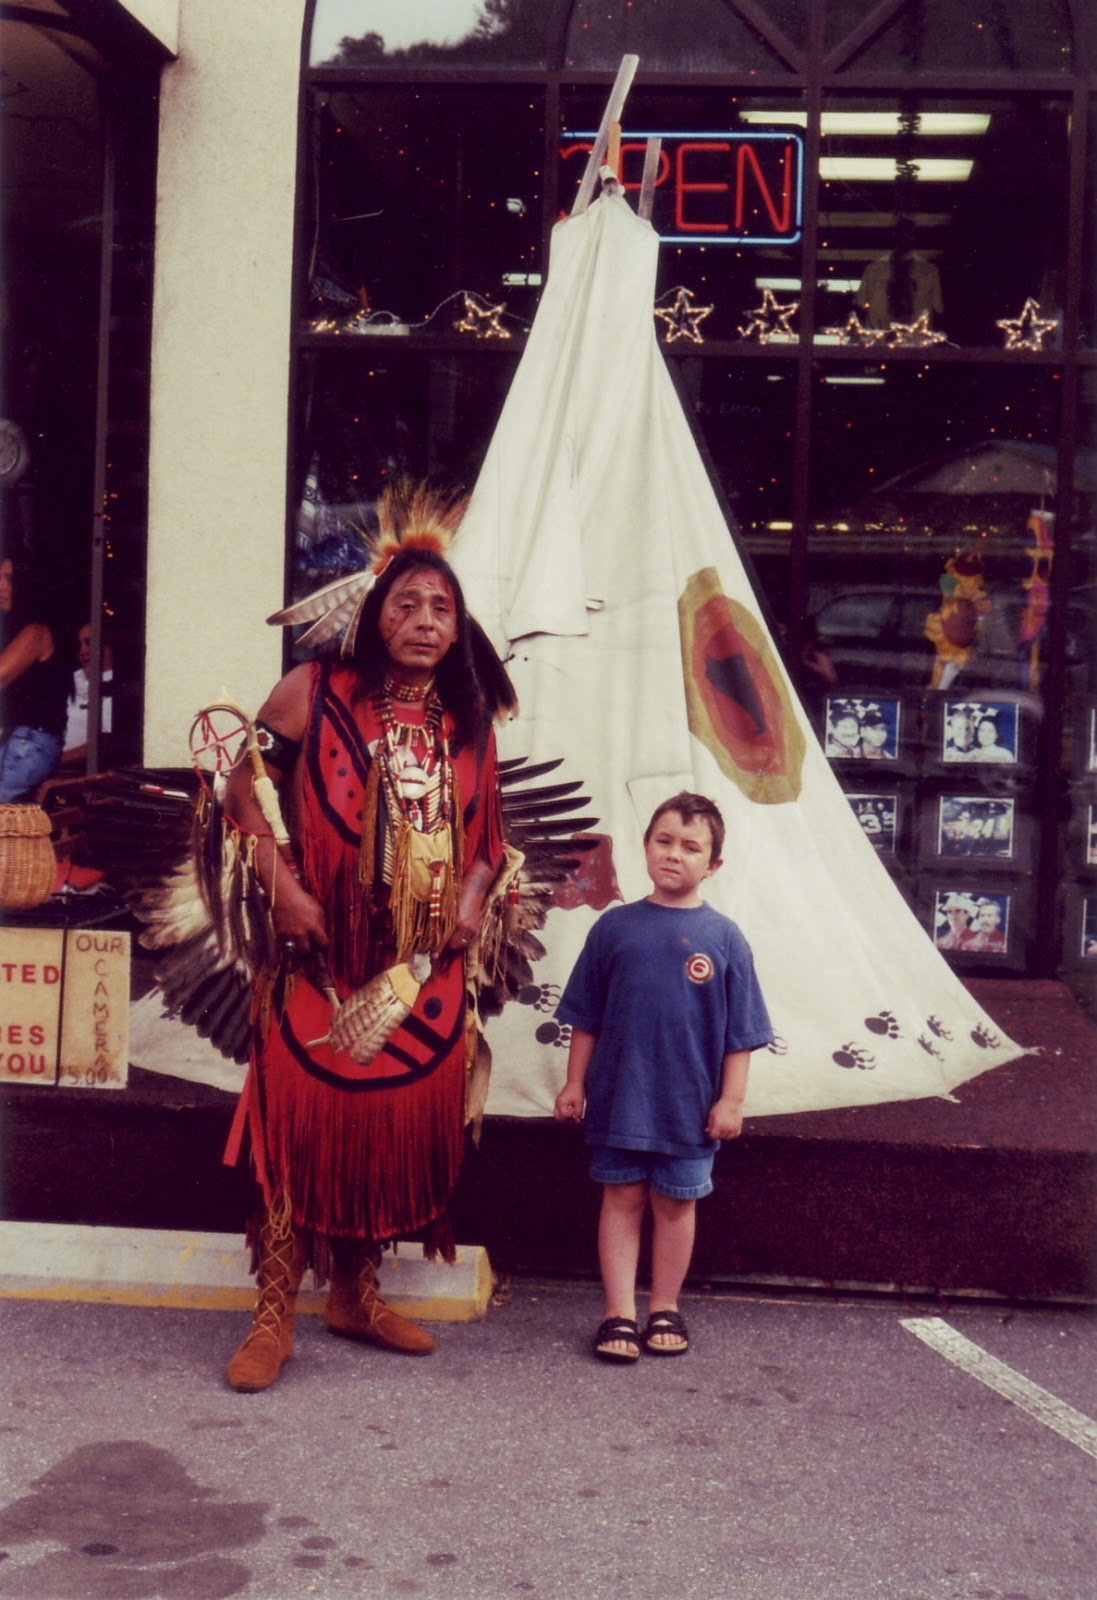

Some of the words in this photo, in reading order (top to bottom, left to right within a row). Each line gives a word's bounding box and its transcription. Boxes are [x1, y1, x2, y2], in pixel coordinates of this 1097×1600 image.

[560, 143, 792, 233] PEN
[75, 934, 125, 955] OUR
[0, 963, 60, 985] TED
[0, 1025, 45, 1046] ES
